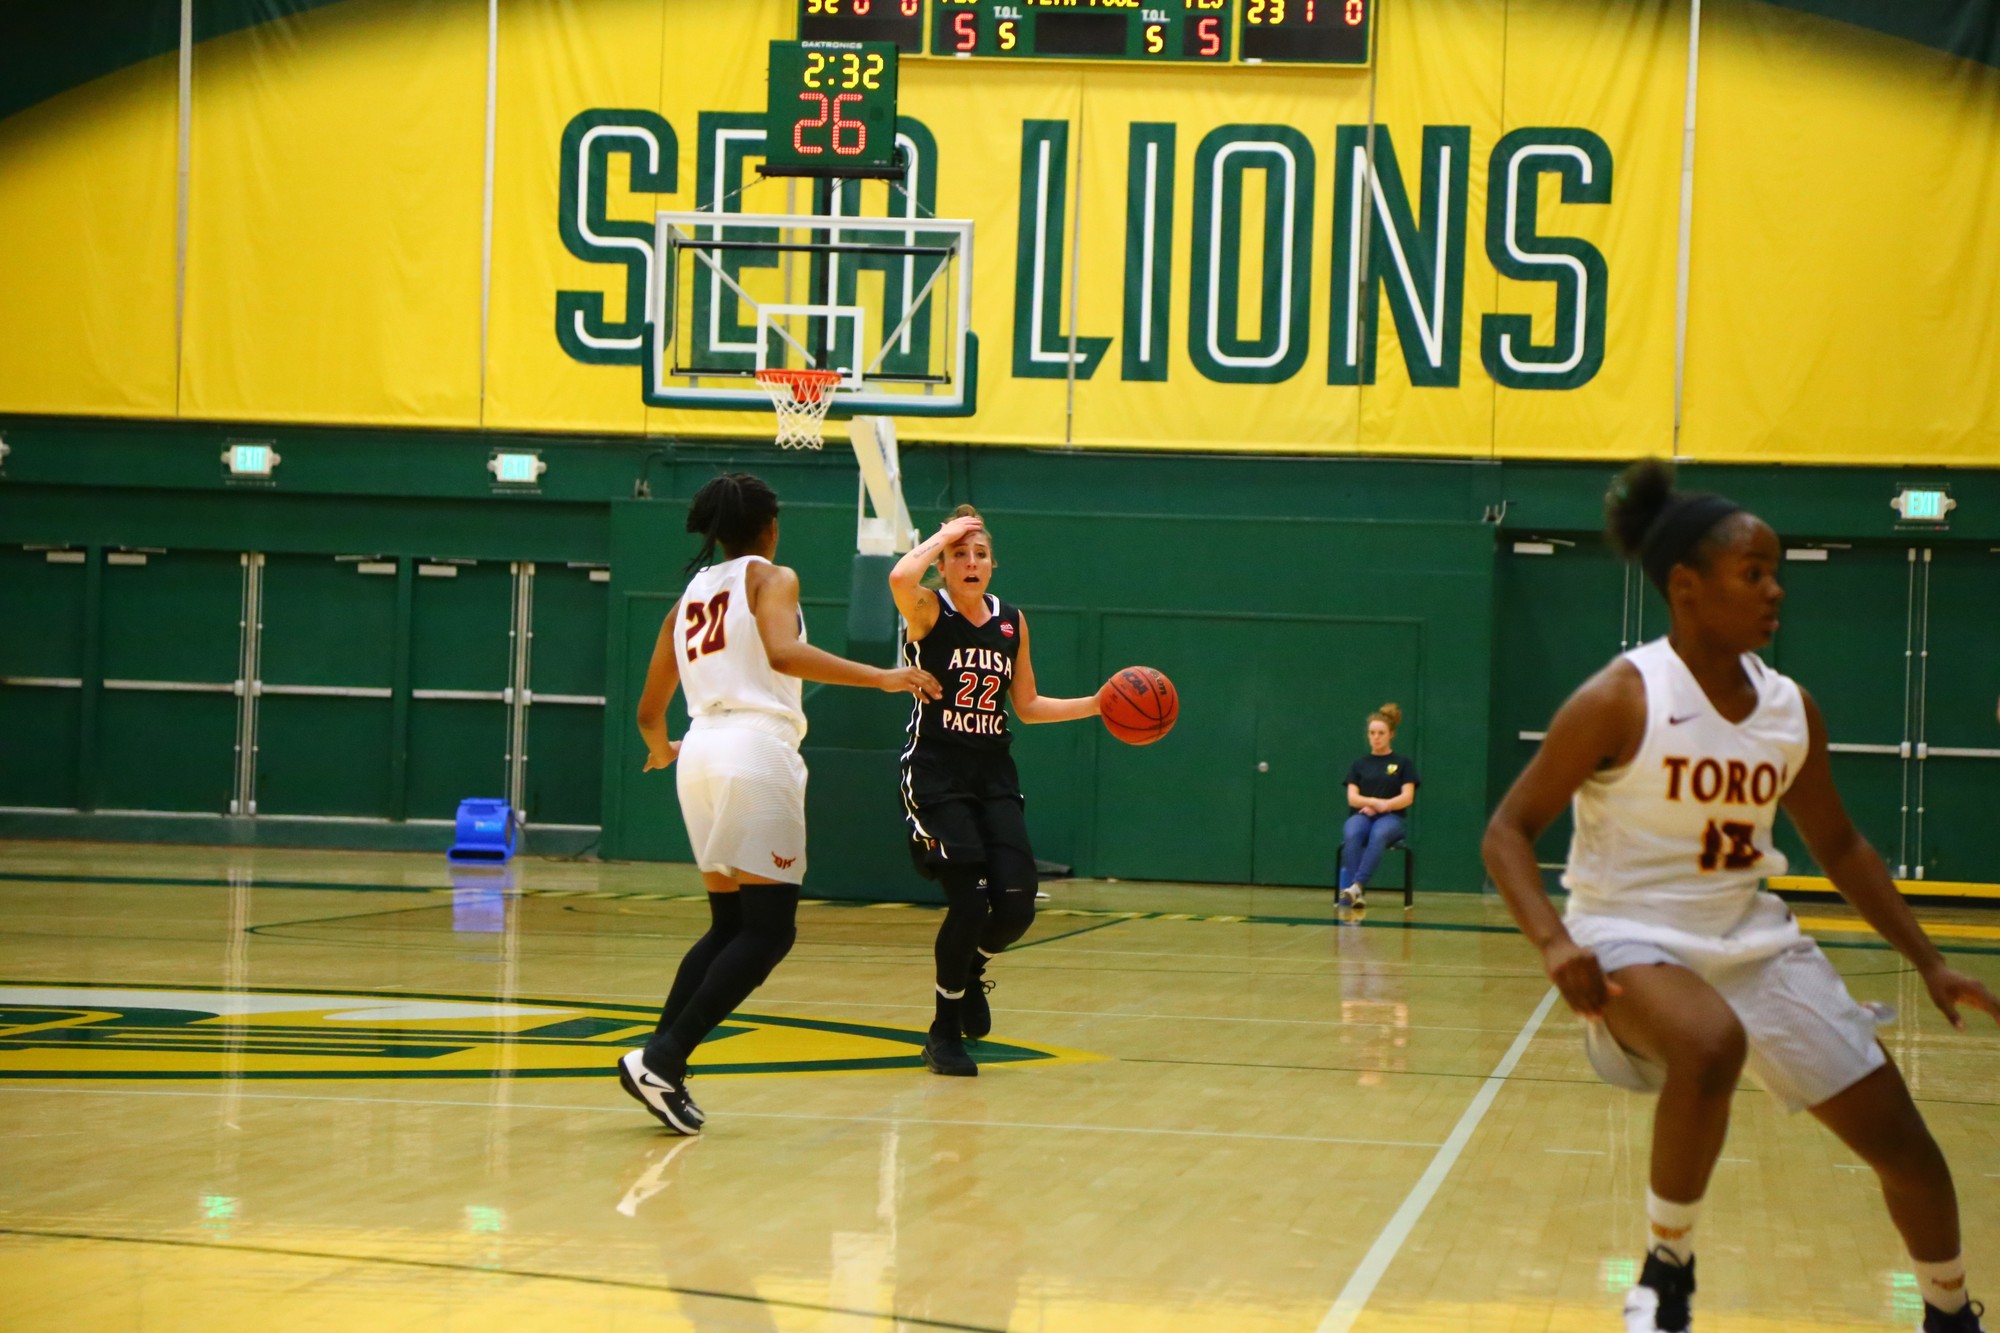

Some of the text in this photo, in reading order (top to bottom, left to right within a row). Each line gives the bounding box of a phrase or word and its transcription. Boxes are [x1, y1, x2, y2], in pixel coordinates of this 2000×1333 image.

[1247, 0, 1285, 24] 23
[801, 41, 863, 49] DAKTRONICS
[954, 13, 976, 50] 5
[998, 22, 1016, 50] 5
[1146, 25, 1163, 53] 5
[1198, 18, 1220, 56] 5
[804, 52, 884, 89] 2:32
[793, 92, 866, 155] 26
[555, 108, 1613, 390] SEA LIONS
[1908, 491, 1940, 516] EXIT
[685, 589, 730, 663] 20
[948, 648, 1012, 680] AZUSA
[955, 671, 1000, 711] 22
[942, 709, 1004, 734] PACIFIC
[1663, 756, 1788, 806] TORO
